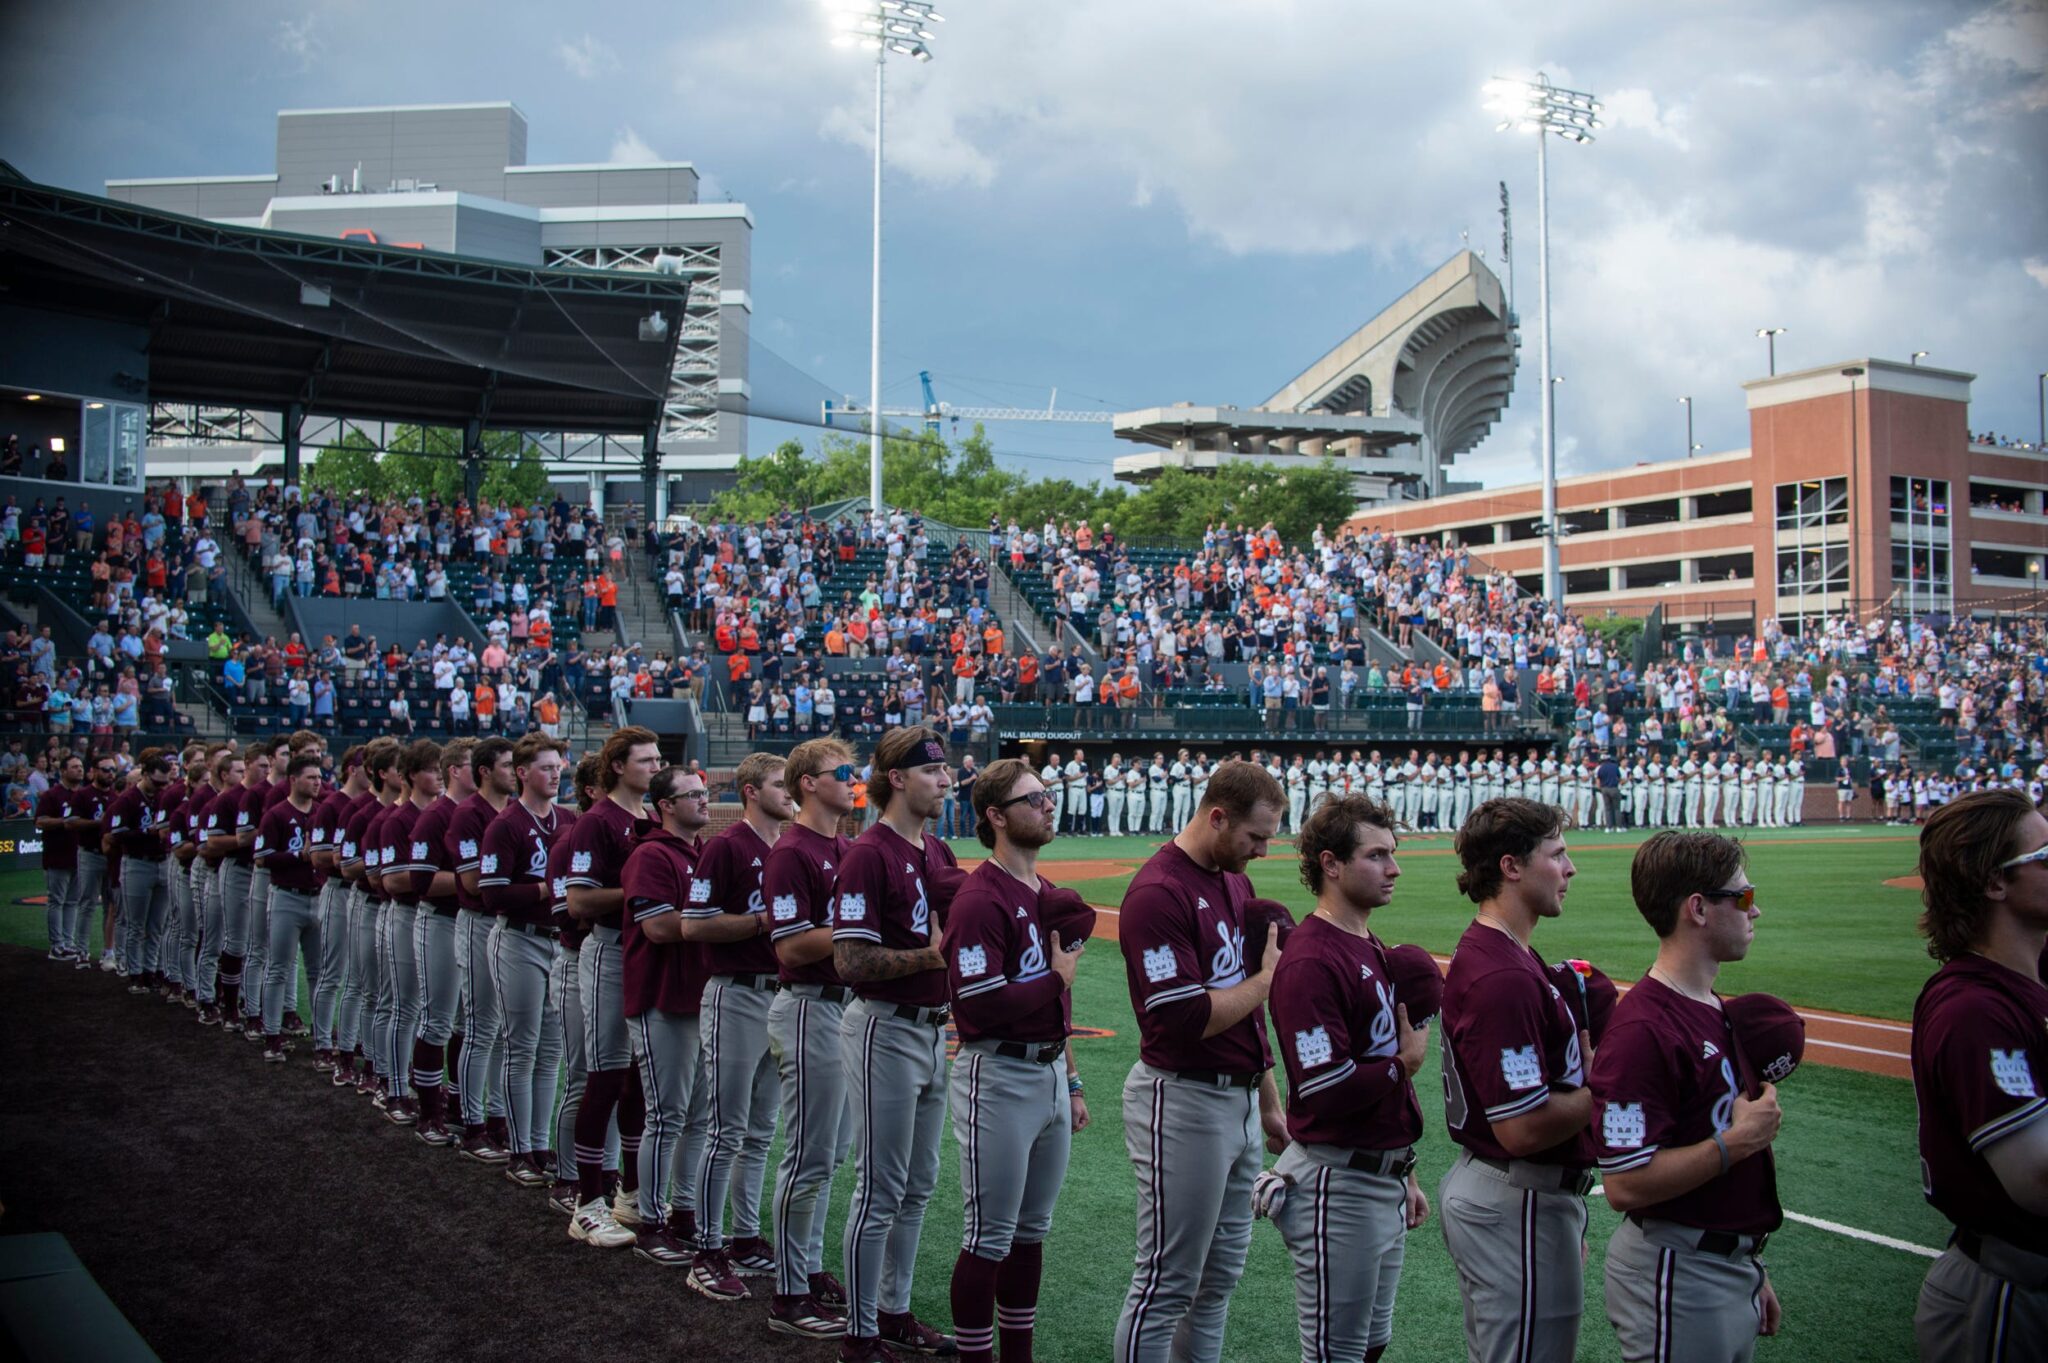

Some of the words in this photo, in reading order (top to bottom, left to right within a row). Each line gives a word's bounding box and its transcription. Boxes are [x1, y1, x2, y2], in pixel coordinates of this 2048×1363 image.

[1000, 731, 1018, 739] HAL
[1019, 731, 1046, 739] BAIRD
[1047, 732, 1082, 740] DUGOUT
